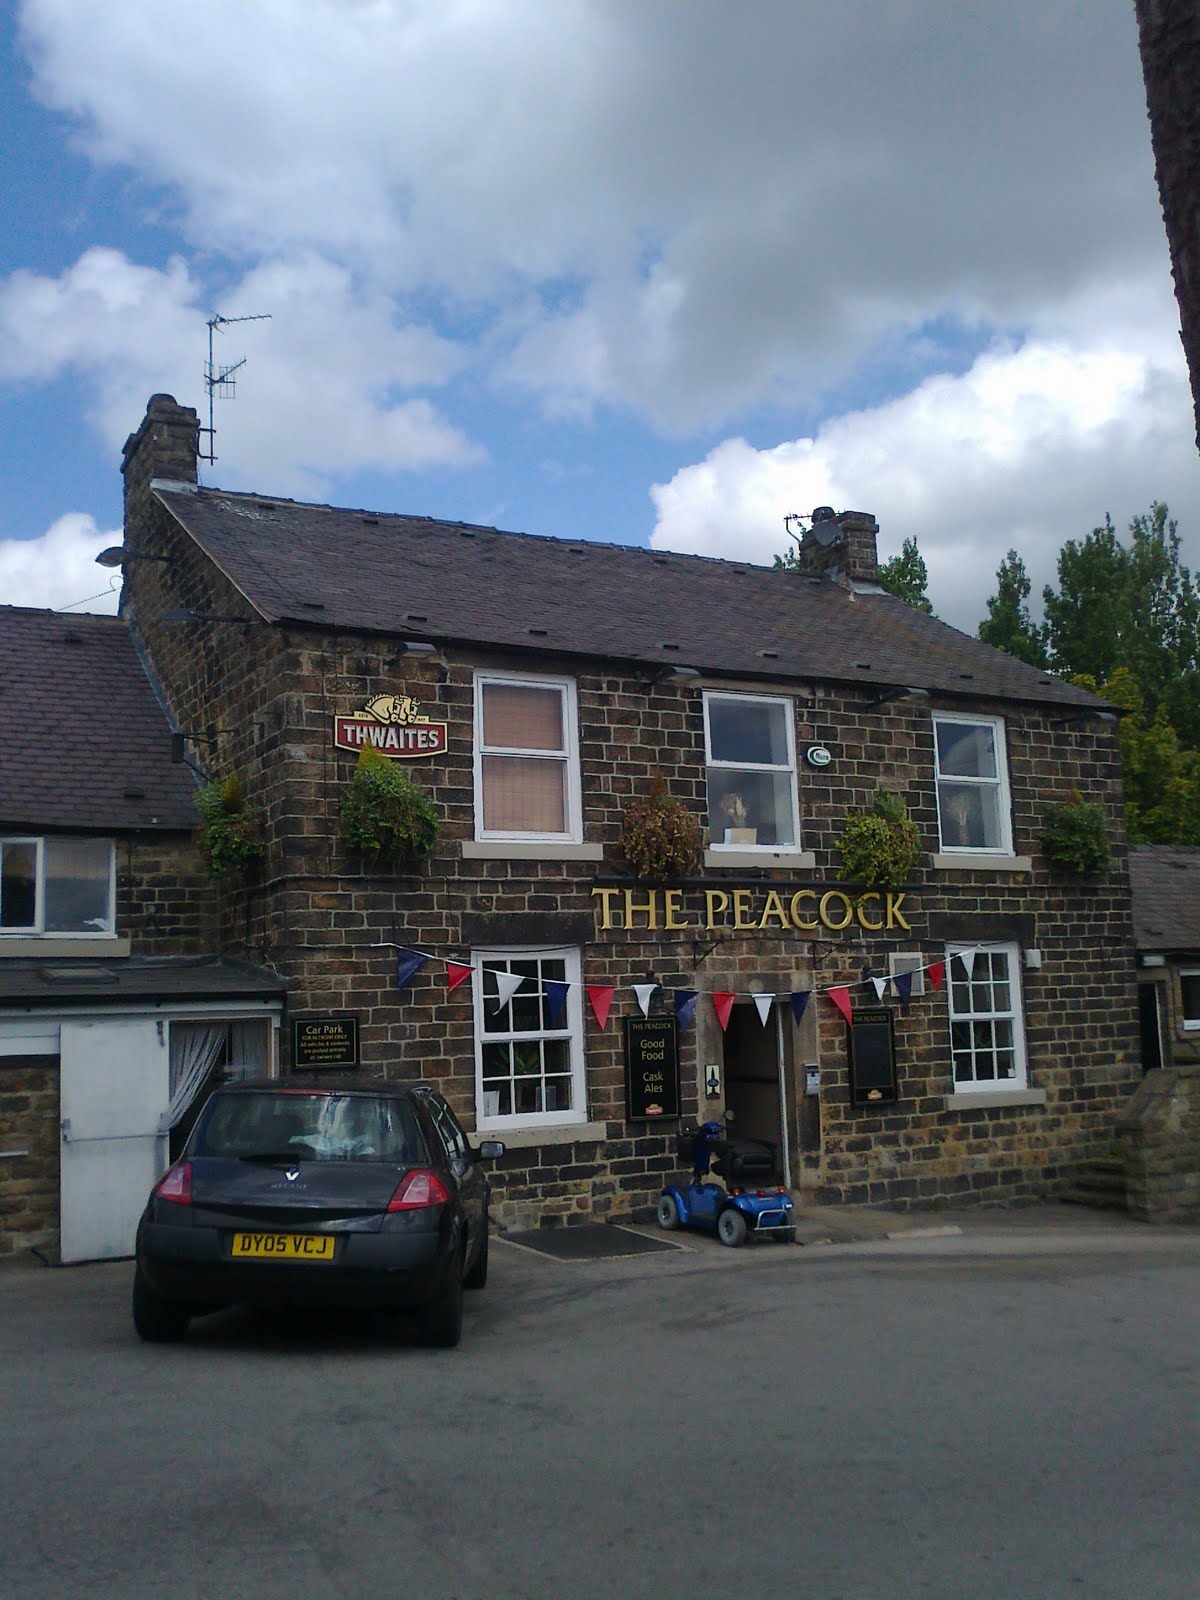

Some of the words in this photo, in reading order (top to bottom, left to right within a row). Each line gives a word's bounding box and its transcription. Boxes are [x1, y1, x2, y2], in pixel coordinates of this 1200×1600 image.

[343, 724, 439, 749] THWAITES
[591, 887, 689, 931] THE
[705, 889, 912, 931] PEACOCK
[306, 1025, 321, 1034] Car
[323, 1024, 344, 1034] Park
[644, 1022, 672, 1030] PEACOCK
[640, 1038, 665, 1049] Good
[641, 1050, 664, 1060] Food
[643, 1071, 664, 1082] Cask
[644, 1083, 664, 1093] Ales
[240, 1234, 287, 1252] DY05
[293, 1236, 327, 1254] VCJ
